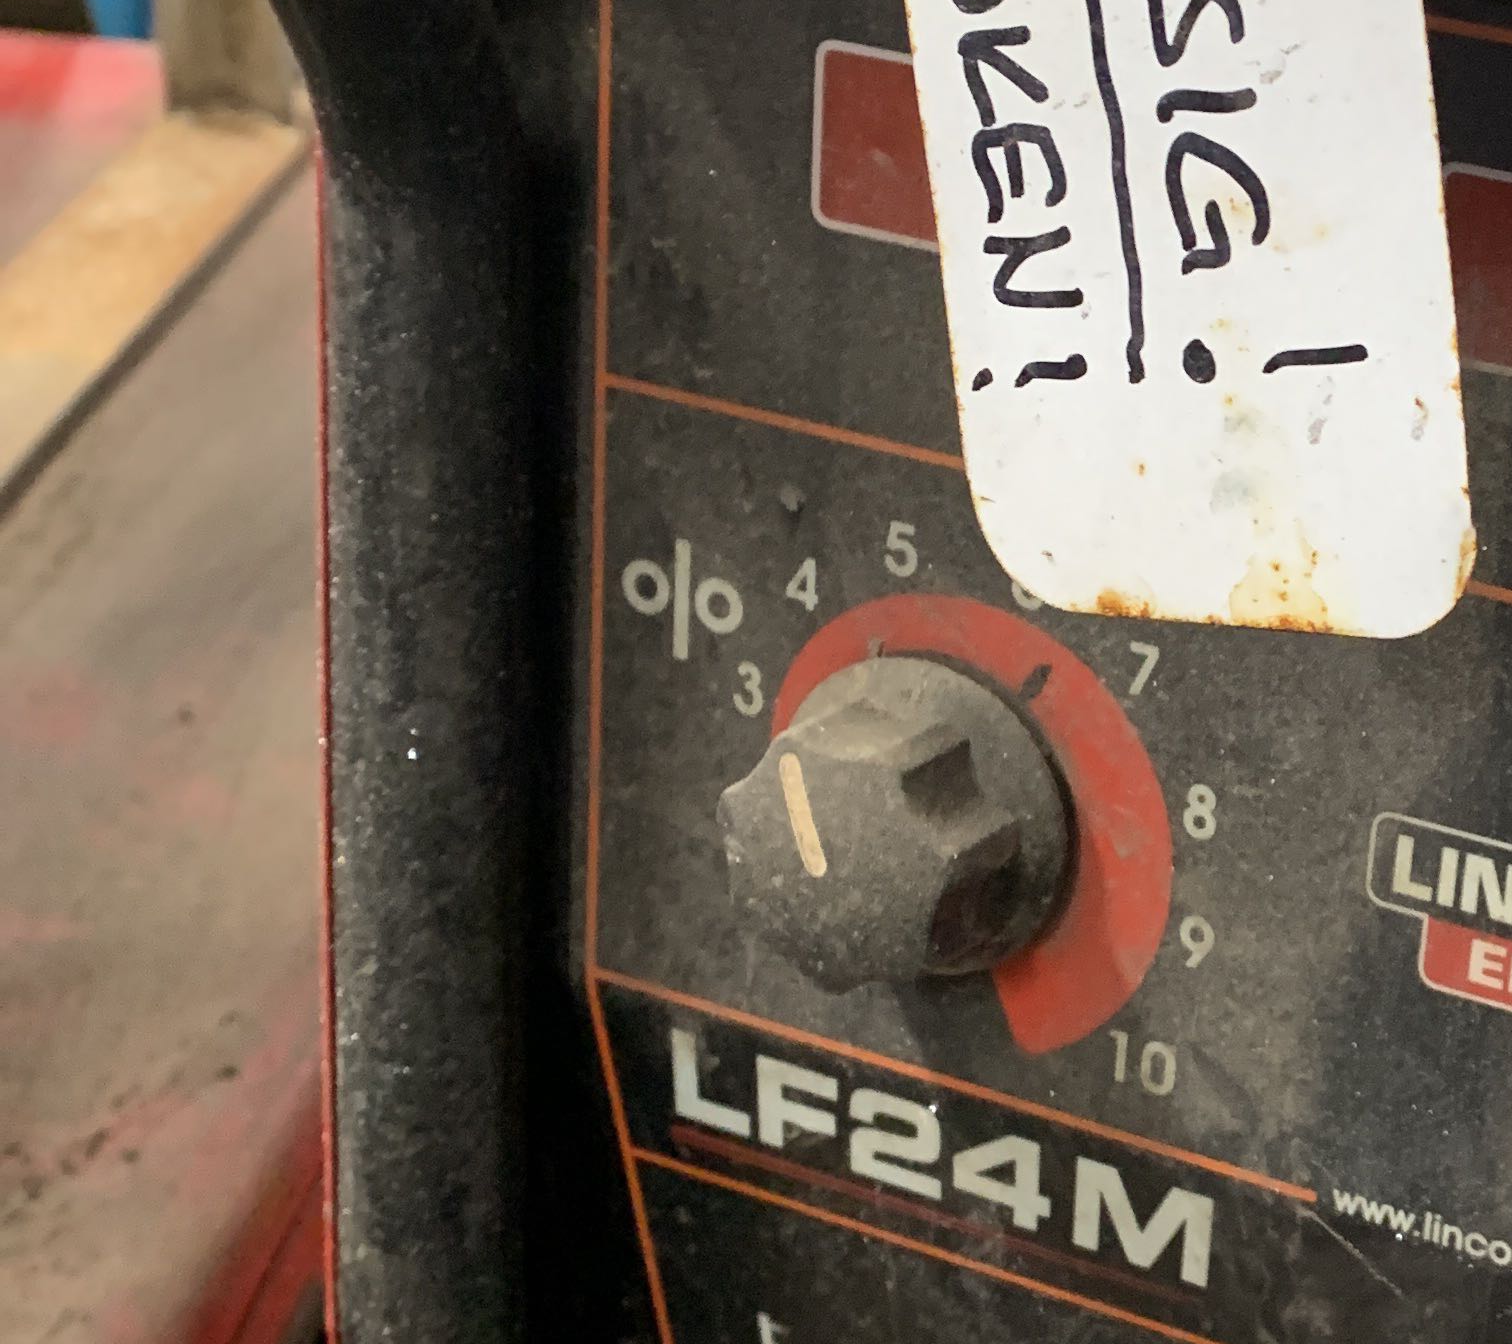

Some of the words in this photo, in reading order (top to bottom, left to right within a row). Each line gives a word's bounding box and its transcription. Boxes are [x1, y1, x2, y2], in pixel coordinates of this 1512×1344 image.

[884, 520, 919, 578] 5
[621, 538, 744, 660] %
[785, 558, 819, 612] 4
[732, 662, 765, 717] 3
[1128, 641, 1161, 697] 7
[1182, 783, 1219, 841] 8
[1179, 915, 1217, 970] 9
[1109, 1029, 1179, 1097] 10
[670, 1028, 1217, 1289] LF24M
